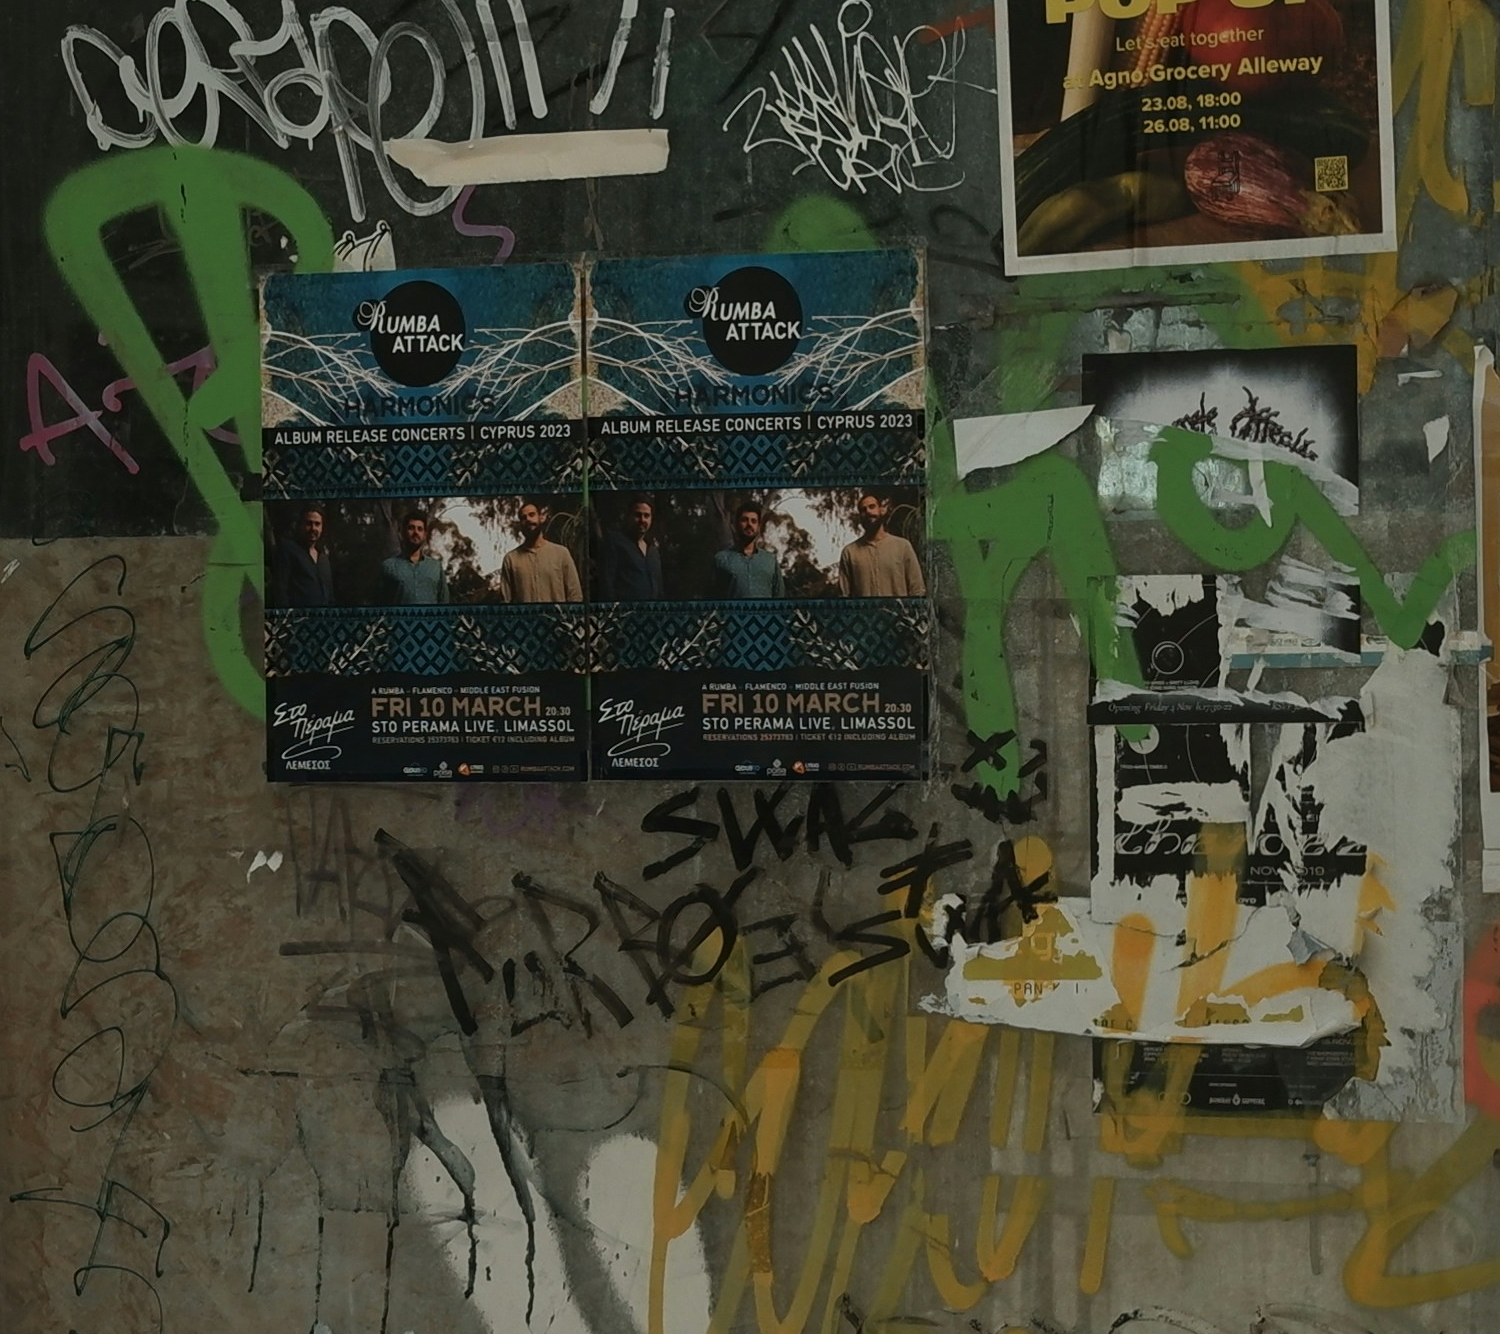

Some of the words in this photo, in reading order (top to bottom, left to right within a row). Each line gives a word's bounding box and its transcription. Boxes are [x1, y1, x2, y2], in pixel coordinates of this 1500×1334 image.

[1115, 36, 1158, 52] Let's
[1159, 33, 1186, 48] eat
[1191, 28, 1265, 48] together
[1089, 68, 1145, 90] Agno
[1149, 61, 1232, 82] Grocery
[1237, 55, 1324, 75] Alleway
[1141, 97, 1194, 112] 23.08,
[1197, 92, 1242, 107] 18:00
[1143, 118, 1196, 134] 26.08,
[1199, 114, 1242, 130] 11:00
[725, 321, 802, 341] ATTACK
[392, 334, 464, 354] ATTACK
[343, 394, 496, 418] HARMONICS
[673, 383, 835, 409] HARMONICS
[274, 430, 323, 445] ALBUM
[326, 429, 388, 444] RELEASE
[391, 426, 466, 442] CONCERTS
[480, 425, 536, 440] CYPRUS
[539, 424, 571, 438] 2023
[600, 420, 651, 435] ALBUM
[655, 418, 721, 433] RELEASE
[725, 417, 802, 432] CONCERTS
[817, 415, 876, 429] CYPRUS
[879, 414, 914, 428] 2023
[460, 686, 489, 694] MIDDLE
[512, 685, 541, 693] FUSION
[795, 682, 826, 690] MIDDLE
[827, 682, 848, 690] EAST
[849, 681, 880, 689] FUSION
[371, 697, 411, 718] FRI
[419, 697, 446, 717] 10
[453, 695, 541, 717] MARCH
[545, 706, 571, 716] 20:30
[702, 693, 744, 714] FRI
[752, 693, 779, 714] 10
[787, 692, 880, 714] MARCH
[884, 703, 912, 713] 20:30
[371, 720, 398, 734] STO
[402, 720, 460, 734] PERAMA
[504, 719, 575, 733] LIMASSOL
[702, 717, 730, 730] STO
[734, 717, 795, 730] PERAMA
[840, 716, 916, 729] LIMASSOL
[465, 736, 490, 744] TICKET
[507, 735, 548, 743] INCLUDING
[549, 735, 575, 743] ALBUM
[888, 732, 916, 740] ALBUM
[285, 760, 331, 770] ΛΕΜΕΣΟΣ
[611, 757, 660, 768] ΛΕΜΕΣΟΣ
